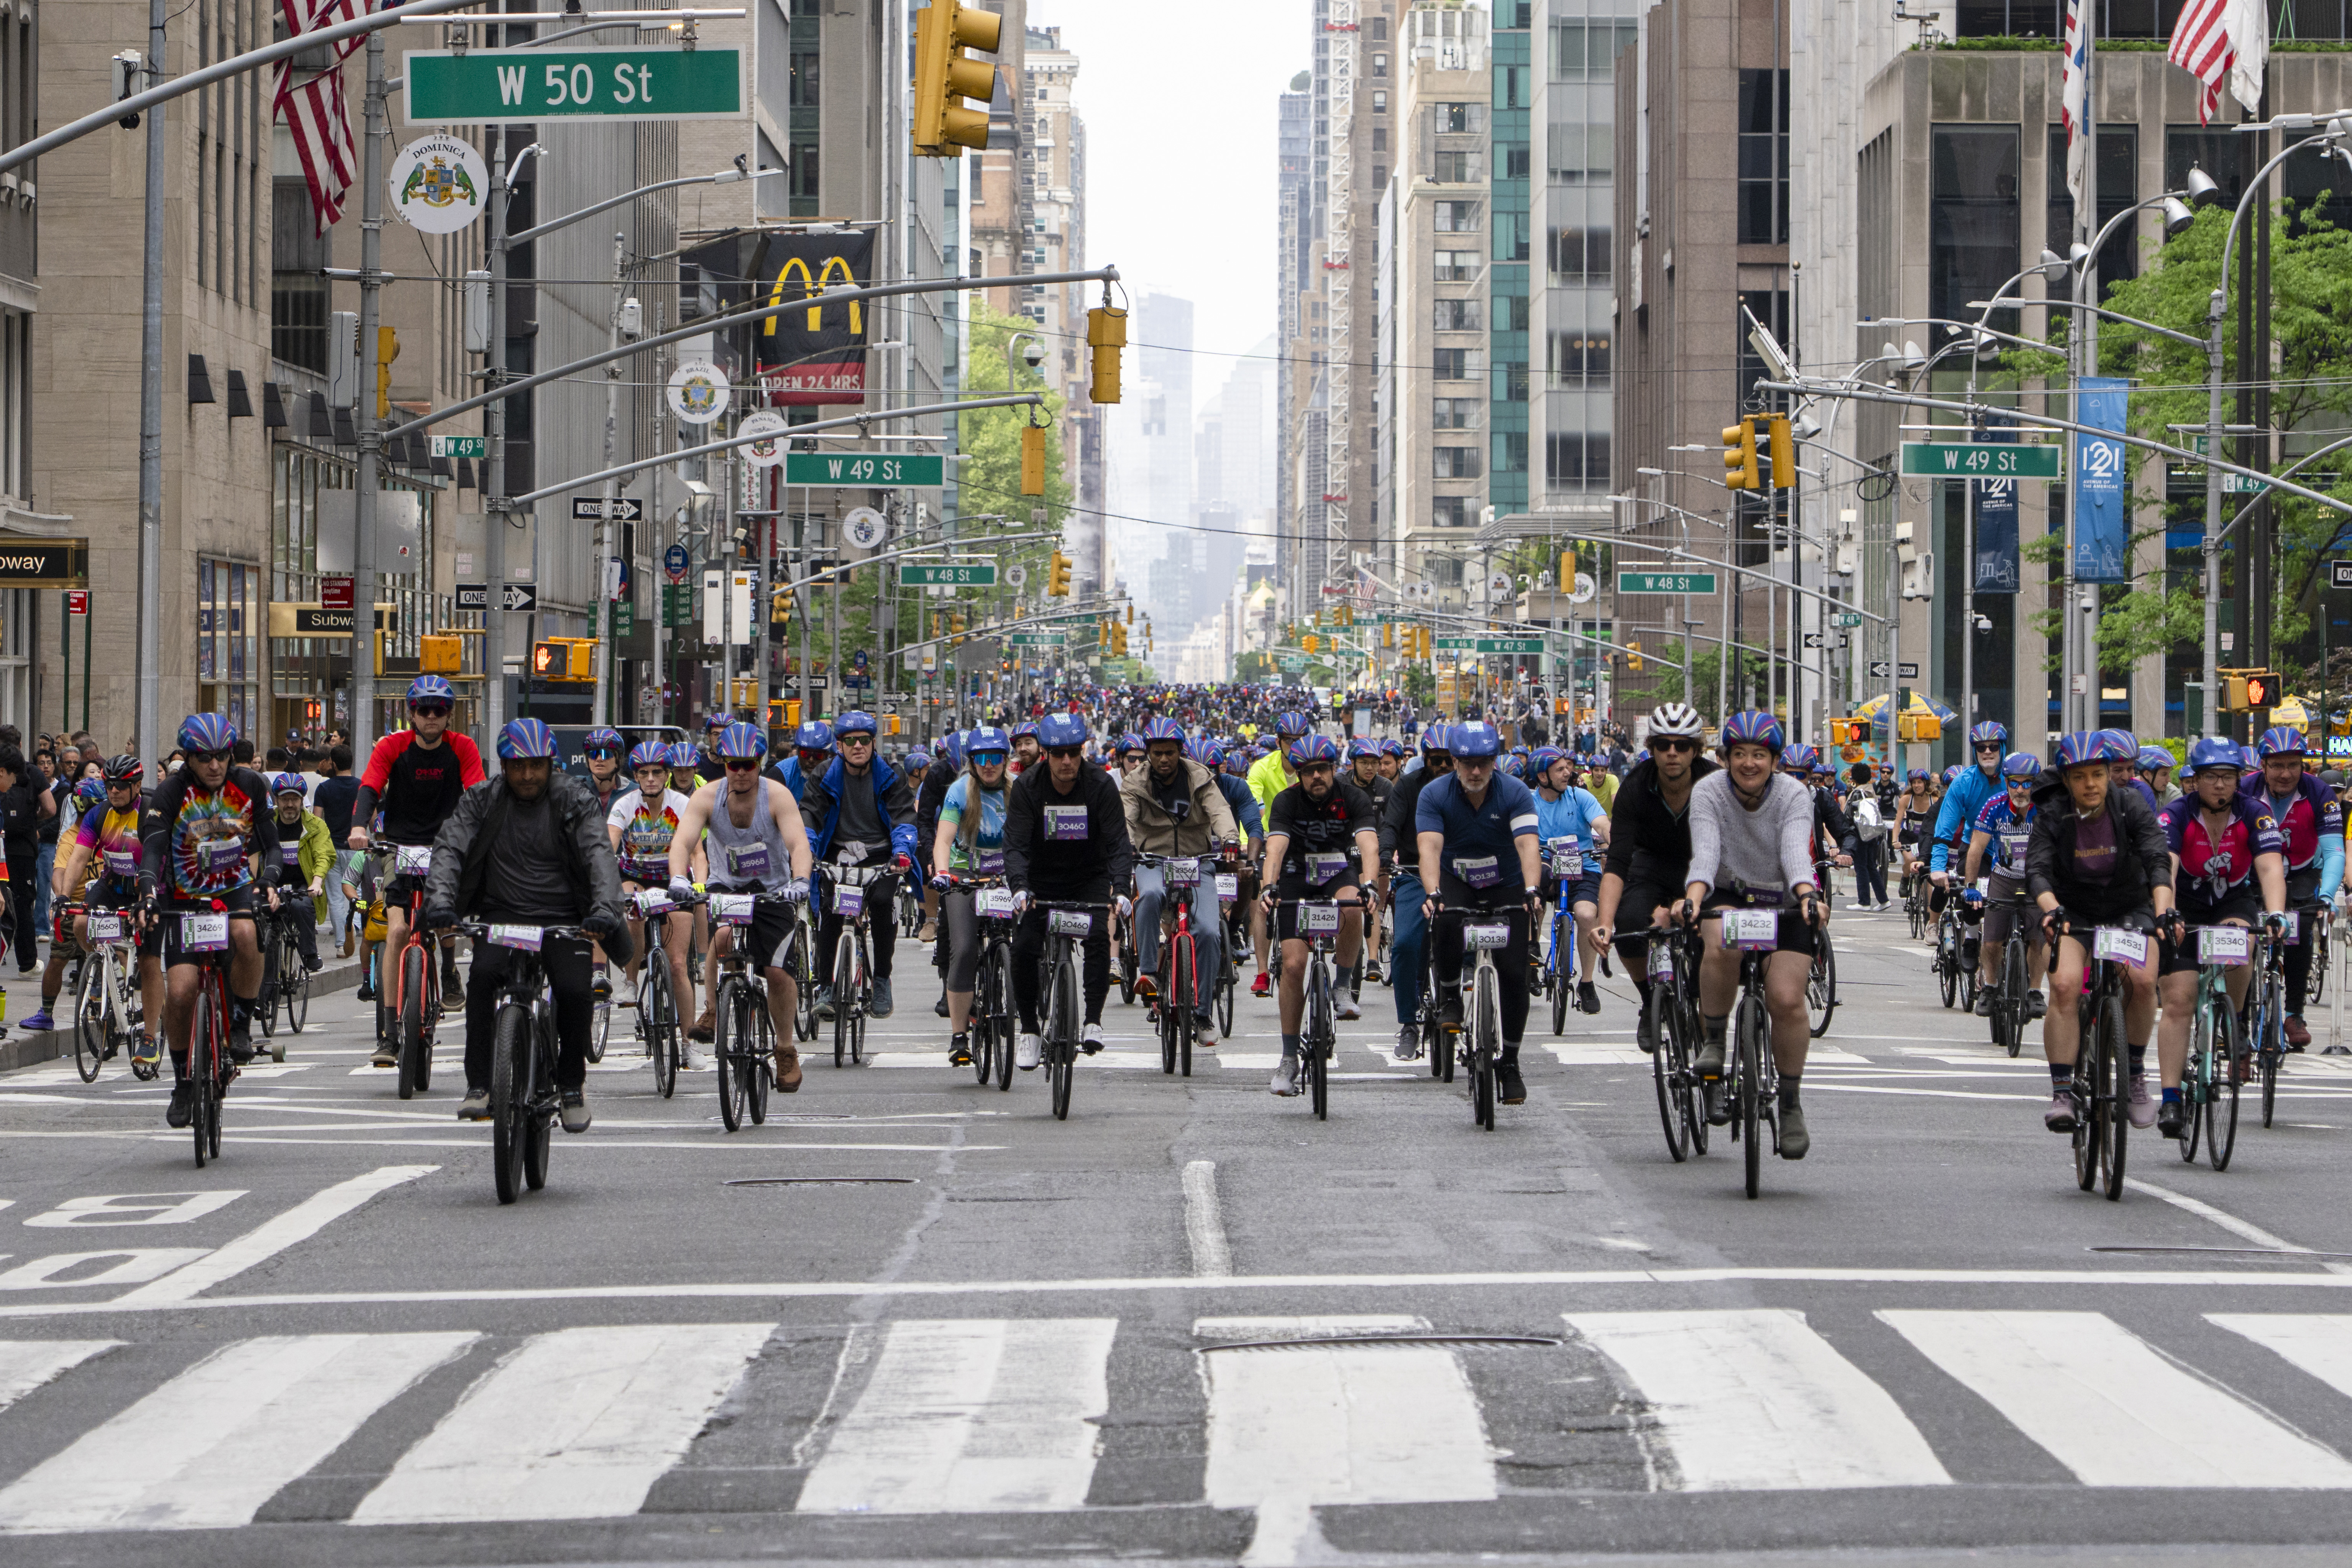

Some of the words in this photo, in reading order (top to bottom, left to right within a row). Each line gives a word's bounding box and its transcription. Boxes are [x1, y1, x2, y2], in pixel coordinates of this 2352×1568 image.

[497, 66, 526, 105] W
[546, 64, 593, 105] 50
[613, 63, 652, 103] St
[412, 144, 465, 159] DOMINICA
[808, 376, 825, 389] 24
[831, 374, 860, 390] HRS
[447, 440, 455, 455] W
[459, 439, 473, 455] 49
[476, 438, 484, 448] St
[1944, 450, 1958, 470] W
[1966, 451, 1989, 470] 49
[1998, 452, 2017, 471] St
[828, 460, 843, 479] W
[850, 460, 874, 479] 49
[882, 460, 902, 480] St
[2237, 476, 2244, 489] W
[583, 504, 602, 513] ONE
[613, 506, 632, 514] WAY
[926, 570, 934, 581] W
[939, 569, 953, 581] 48
[959, 569, 970, 581] St
[1645, 577, 1654, 589] W
[1658, 577, 1673, 589] 48
[1678, 577, 1690, 591] St
[464, 593, 486, 603] ONE
[503, 593, 520, 603] AY
[617, 604, 629, 612] QM1
[311, 613, 353, 626] Subw
[678, 617, 692, 625] QM20
[617, 627, 629, 635] QM6
[1494, 642, 1501, 651] W
[1504, 642, 1514, 651] 47
[1517, 642, 1526, 651] St
[1058, 823, 1086, 831] 30460
[215, 854, 238, 865] 34269
[741, 858, 765, 868] 35968
[1469, 872, 1496, 881] 30138
[725, 899, 749, 908] 35968
[842, 899, 858, 909] 32971
[990, 895, 1011, 903] 35969
[1311, 913, 1336, 921] 31426
[97, 923, 118, 931] 35609
[197, 924, 223, 933] 34269
[1061, 921, 1088, 929] 30460
[1741, 919, 1772, 928] 34232
[1479, 936, 1507, 944] 30138
[2114, 937, 2142, 952] 34531
[2215, 938, 2245, 946] 35340
